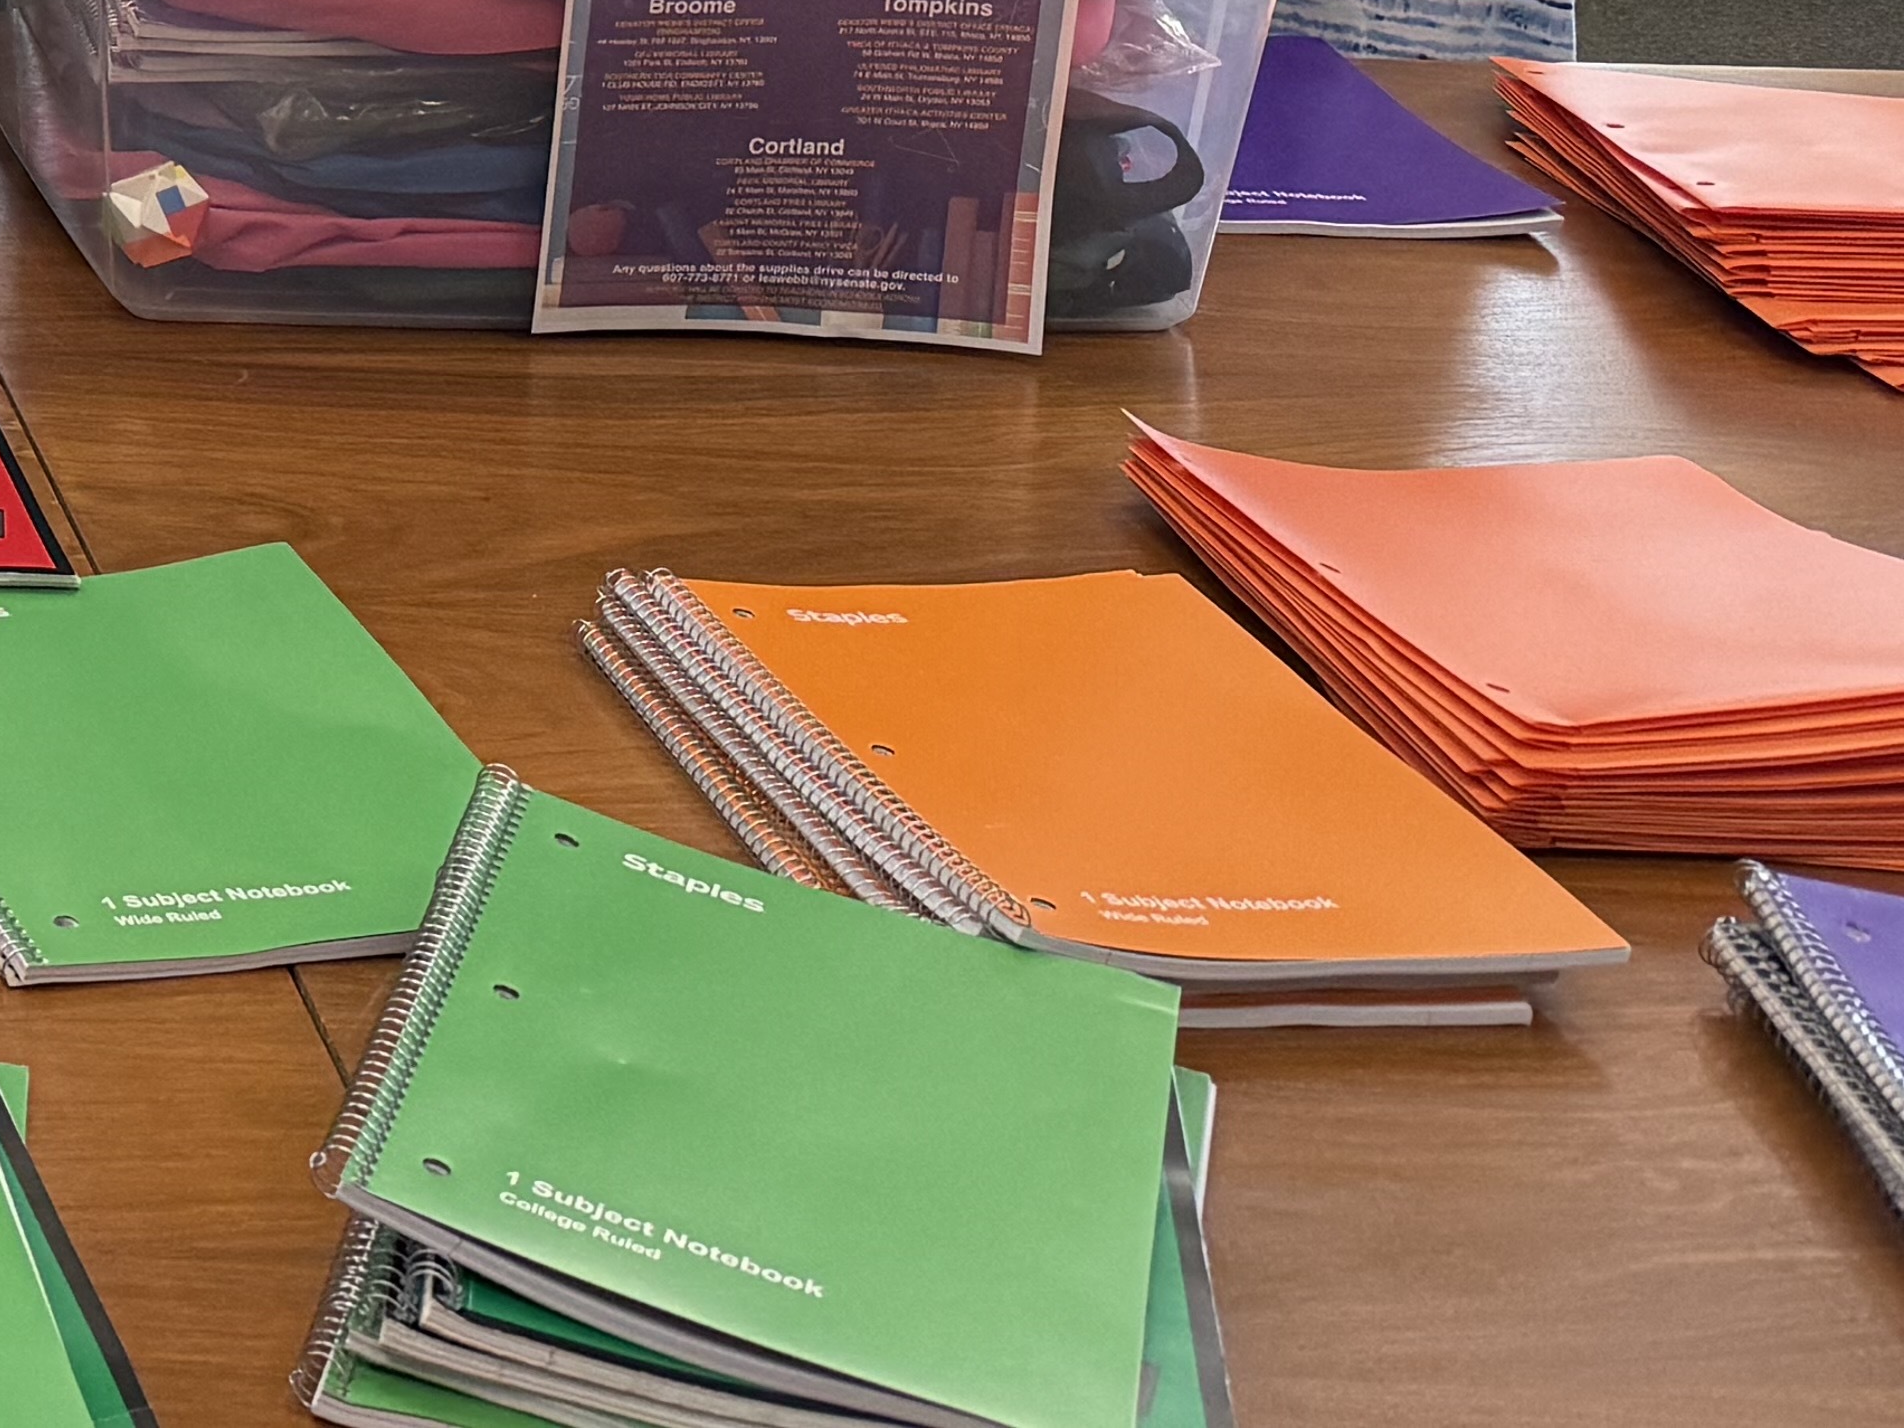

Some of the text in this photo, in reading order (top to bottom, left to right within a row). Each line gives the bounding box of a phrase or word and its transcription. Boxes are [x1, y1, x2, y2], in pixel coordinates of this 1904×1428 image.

[748, 137, 845, 156] Cortland
[786, 607, 909, 627] Staples
[101, 877, 352, 912] 1 Subject Notebook
[620, 853, 765, 914] Staples
[1079, 890, 1339, 912] 1 Subject Notebook
[113, 908, 222, 928] Wide Ruled
[498, 1189, 662, 1263] College Ruled
[505, 1171, 826, 1301] 1 Subject Notebook
